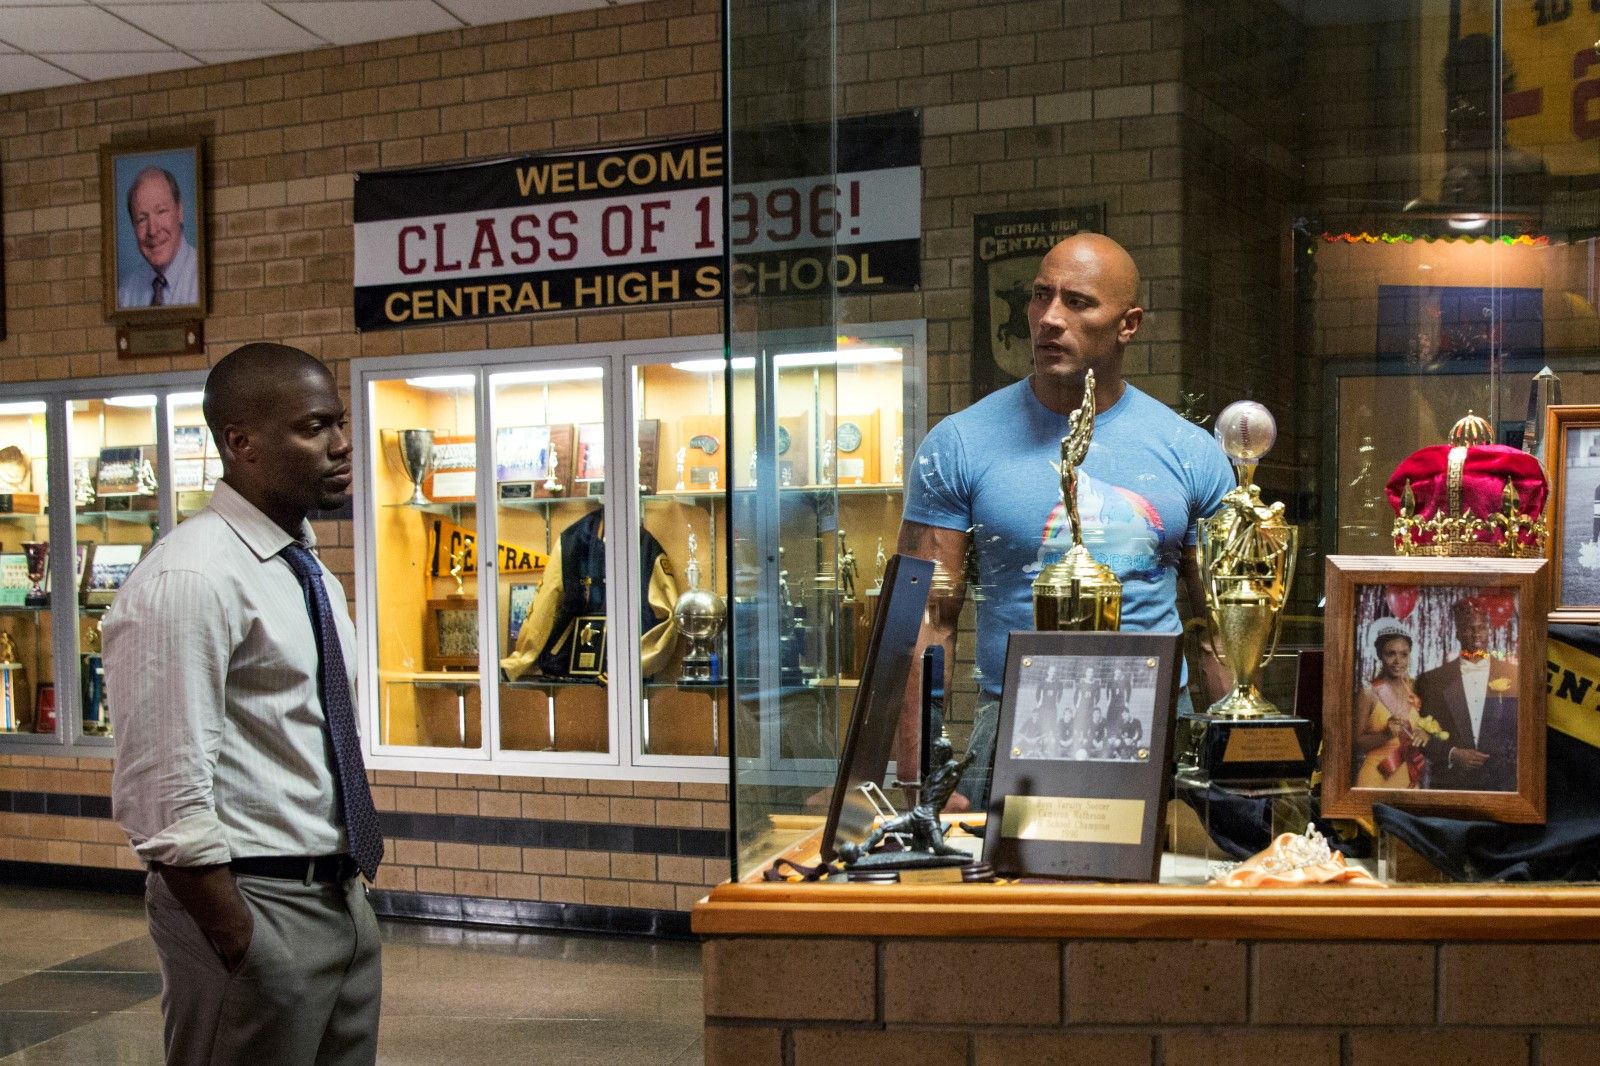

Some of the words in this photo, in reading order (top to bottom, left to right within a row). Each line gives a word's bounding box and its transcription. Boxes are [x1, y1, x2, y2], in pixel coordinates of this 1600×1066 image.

[516, 146, 723, 197] WELCOME
[398, 210, 579, 275] CLASS
[602, 200, 671, 257] OF
[695, 181, 860, 249] 1996!
[994, 223, 1046, 235] CENTRAL
[385, 280, 562, 322] CENTRAL
[575, 269, 680, 308] HIGH
[695, 253, 884, 298] SCHOOL
